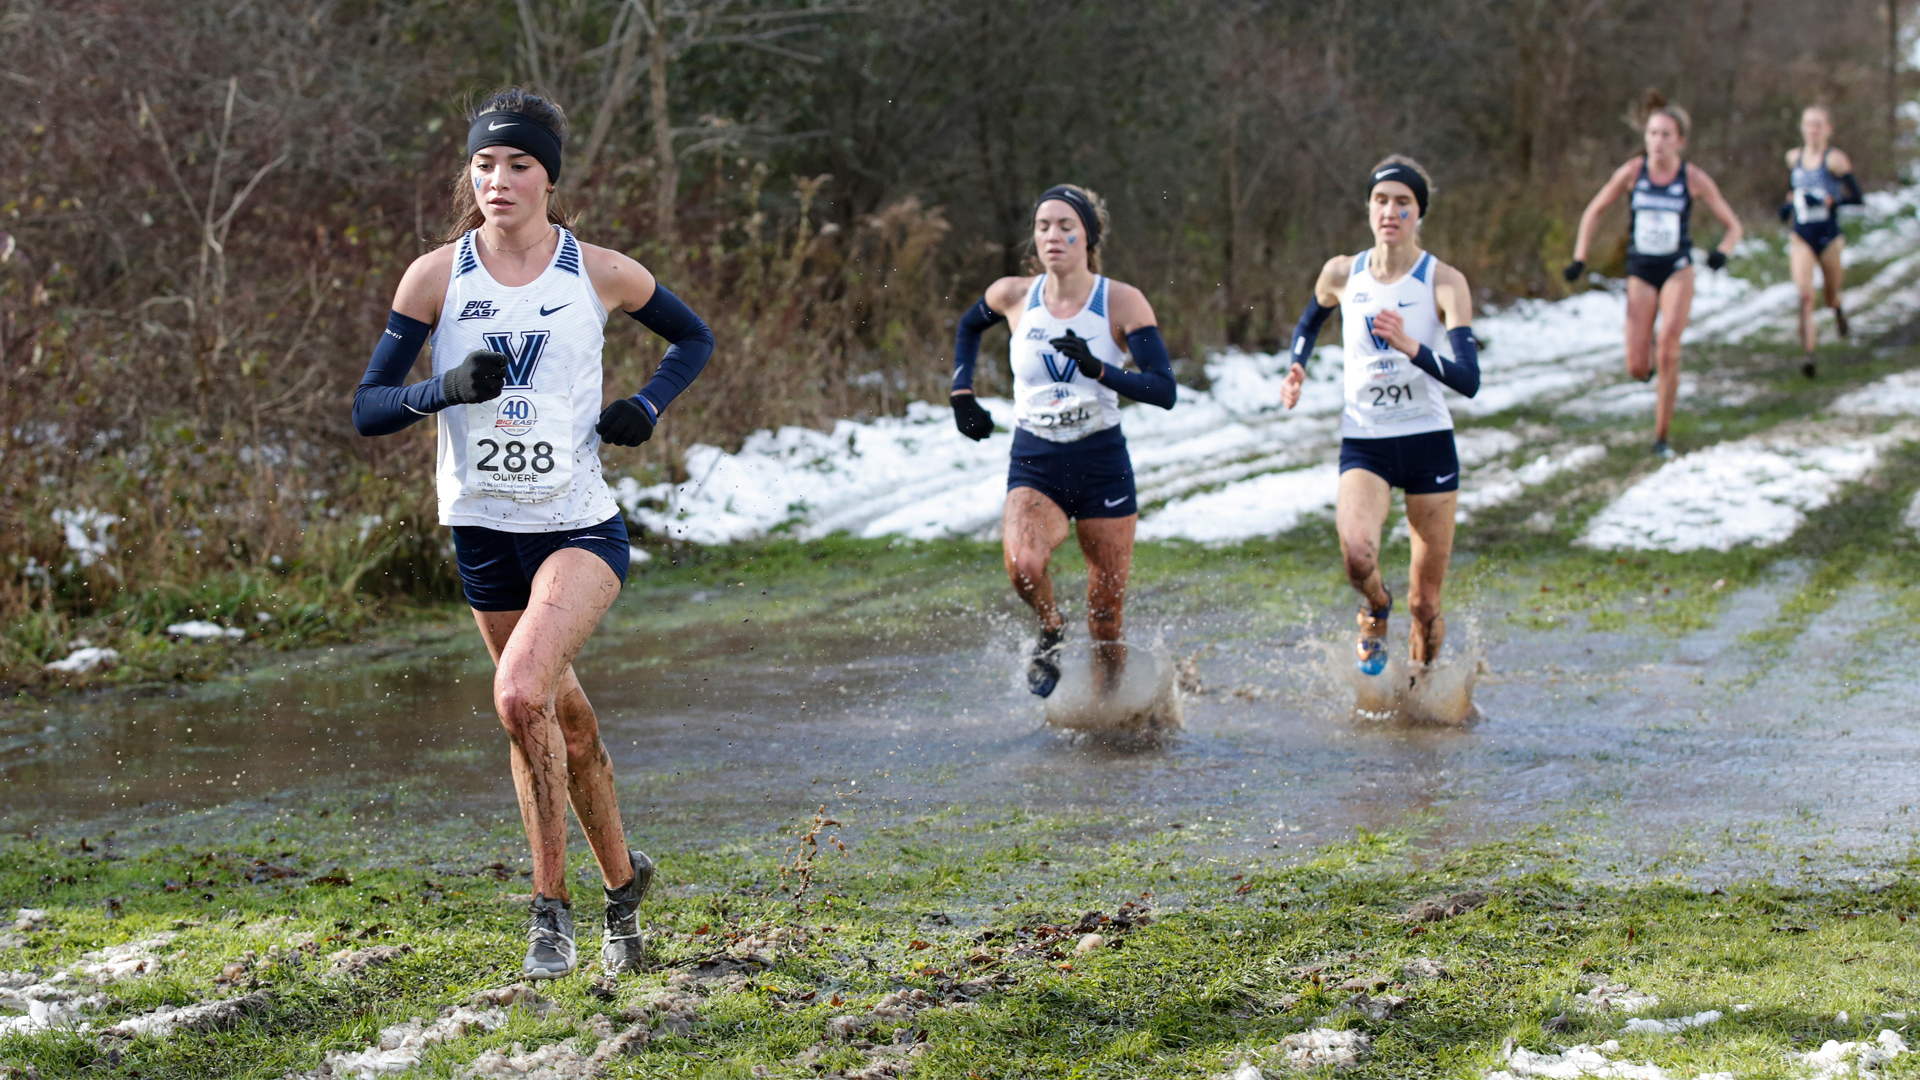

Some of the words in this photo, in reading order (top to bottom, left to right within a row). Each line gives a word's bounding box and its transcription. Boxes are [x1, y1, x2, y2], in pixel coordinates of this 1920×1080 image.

[460, 309, 500, 317] EAST
[465, 301, 493, 309] BIG
[483, 330, 550, 389] V
[1037, 350, 1081, 383] V
[1369, 384, 1412, 407] 291
[502, 400, 529, 419] 40
[1041, 407, 1090, 428] 284
[477, 438, 555, 473] 288
[492, 473, 538, 482] OLIVERE
